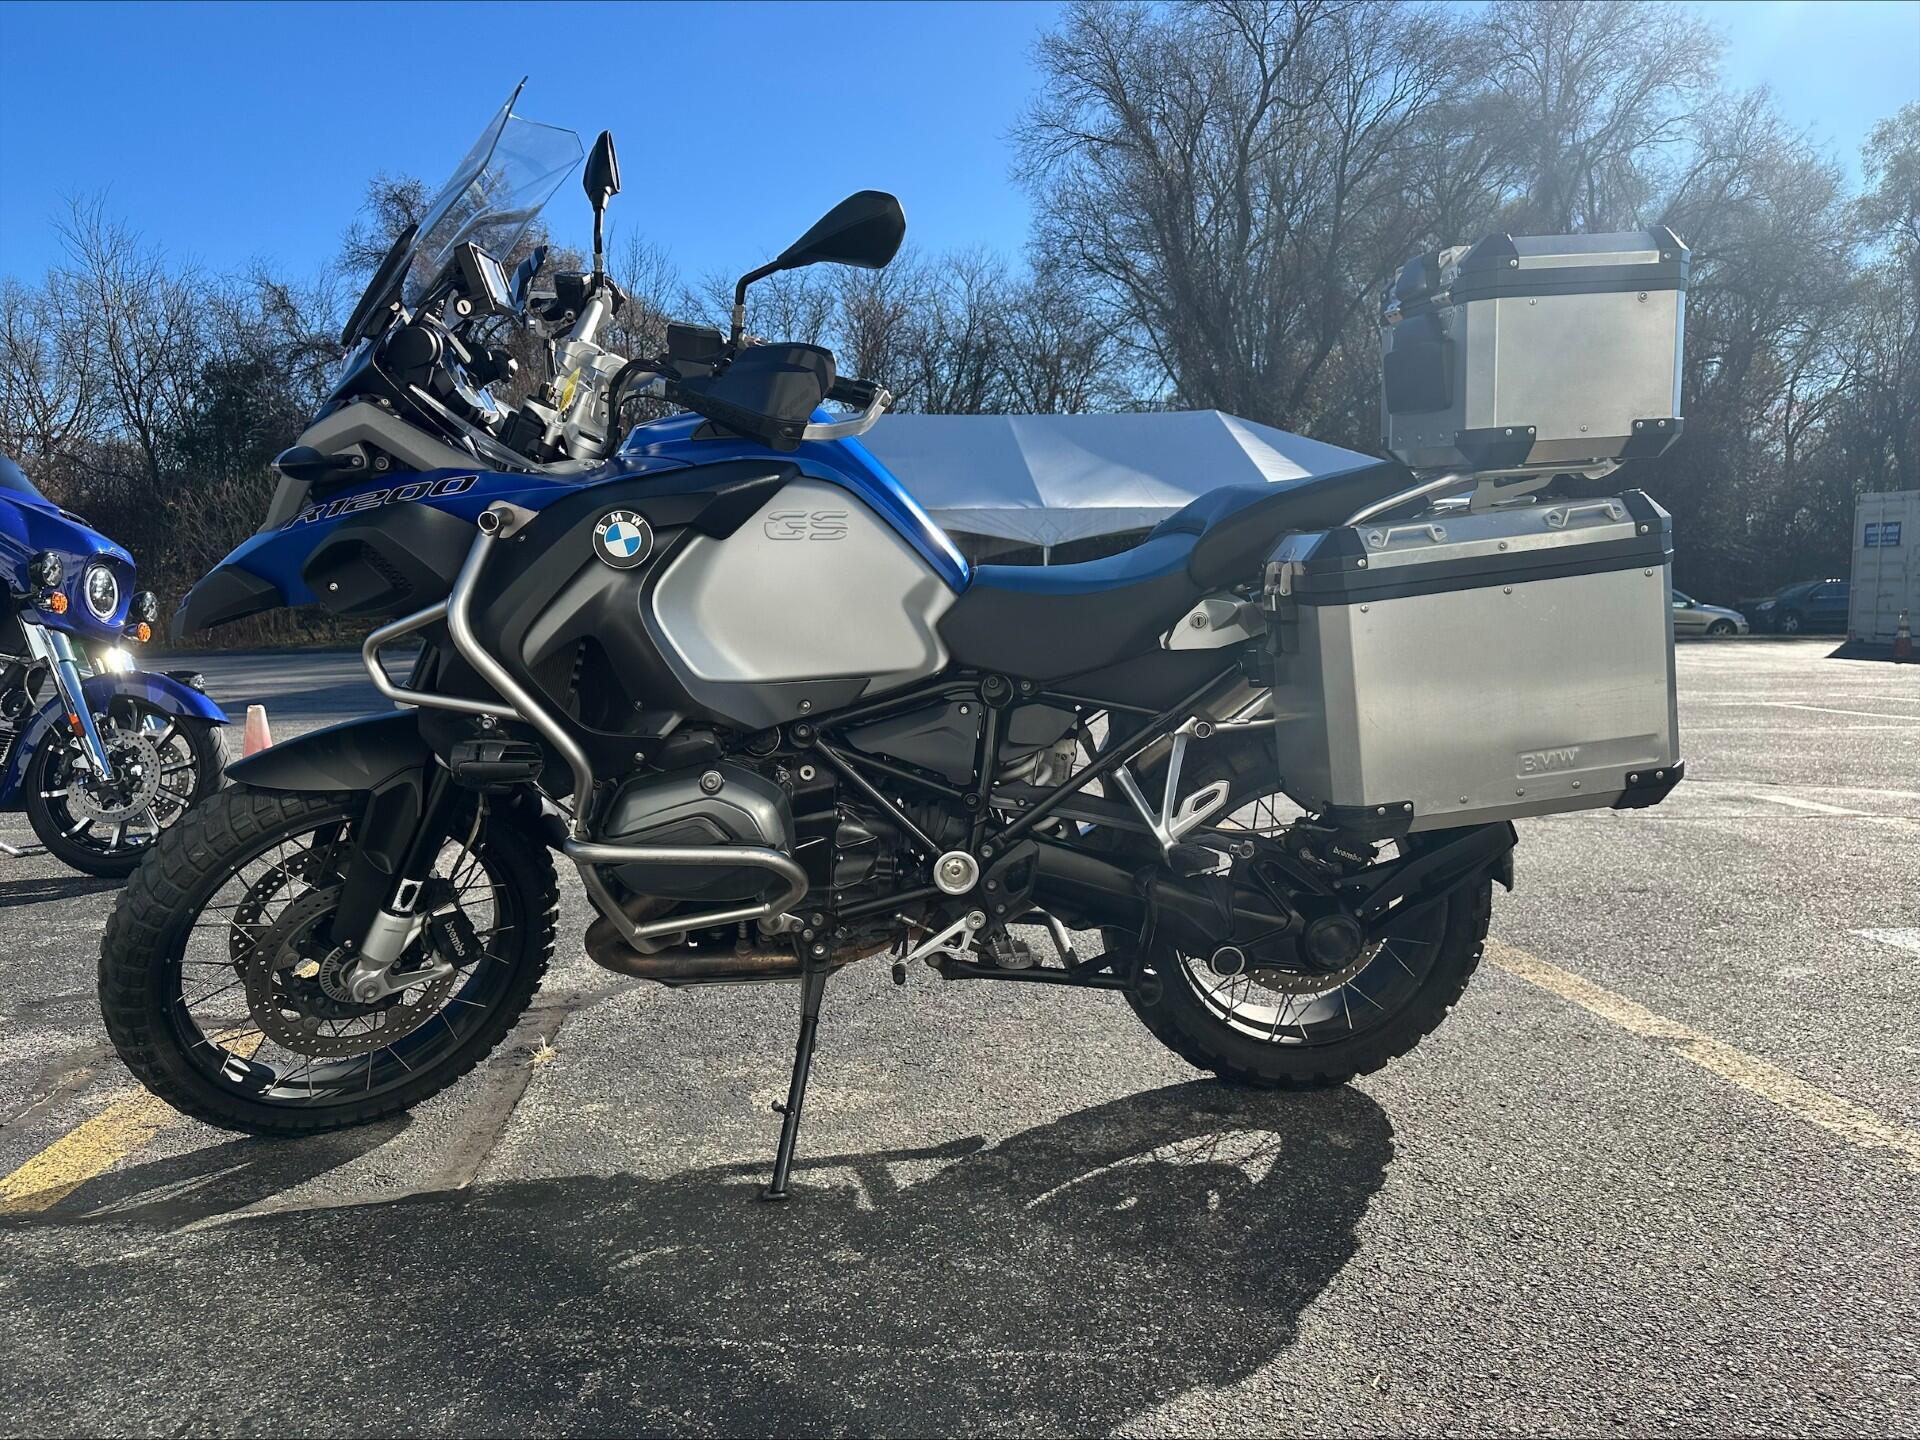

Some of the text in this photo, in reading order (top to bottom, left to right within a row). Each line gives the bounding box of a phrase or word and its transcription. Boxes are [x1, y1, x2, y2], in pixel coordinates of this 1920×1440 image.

[280, 475, 479, 531] R1200
[596, 512, 643, 535] BMW
[764, 510, 848, 540] GS
[1520, 746, 1579, 772] BMW
[444, 921, 465, 956] brembo
